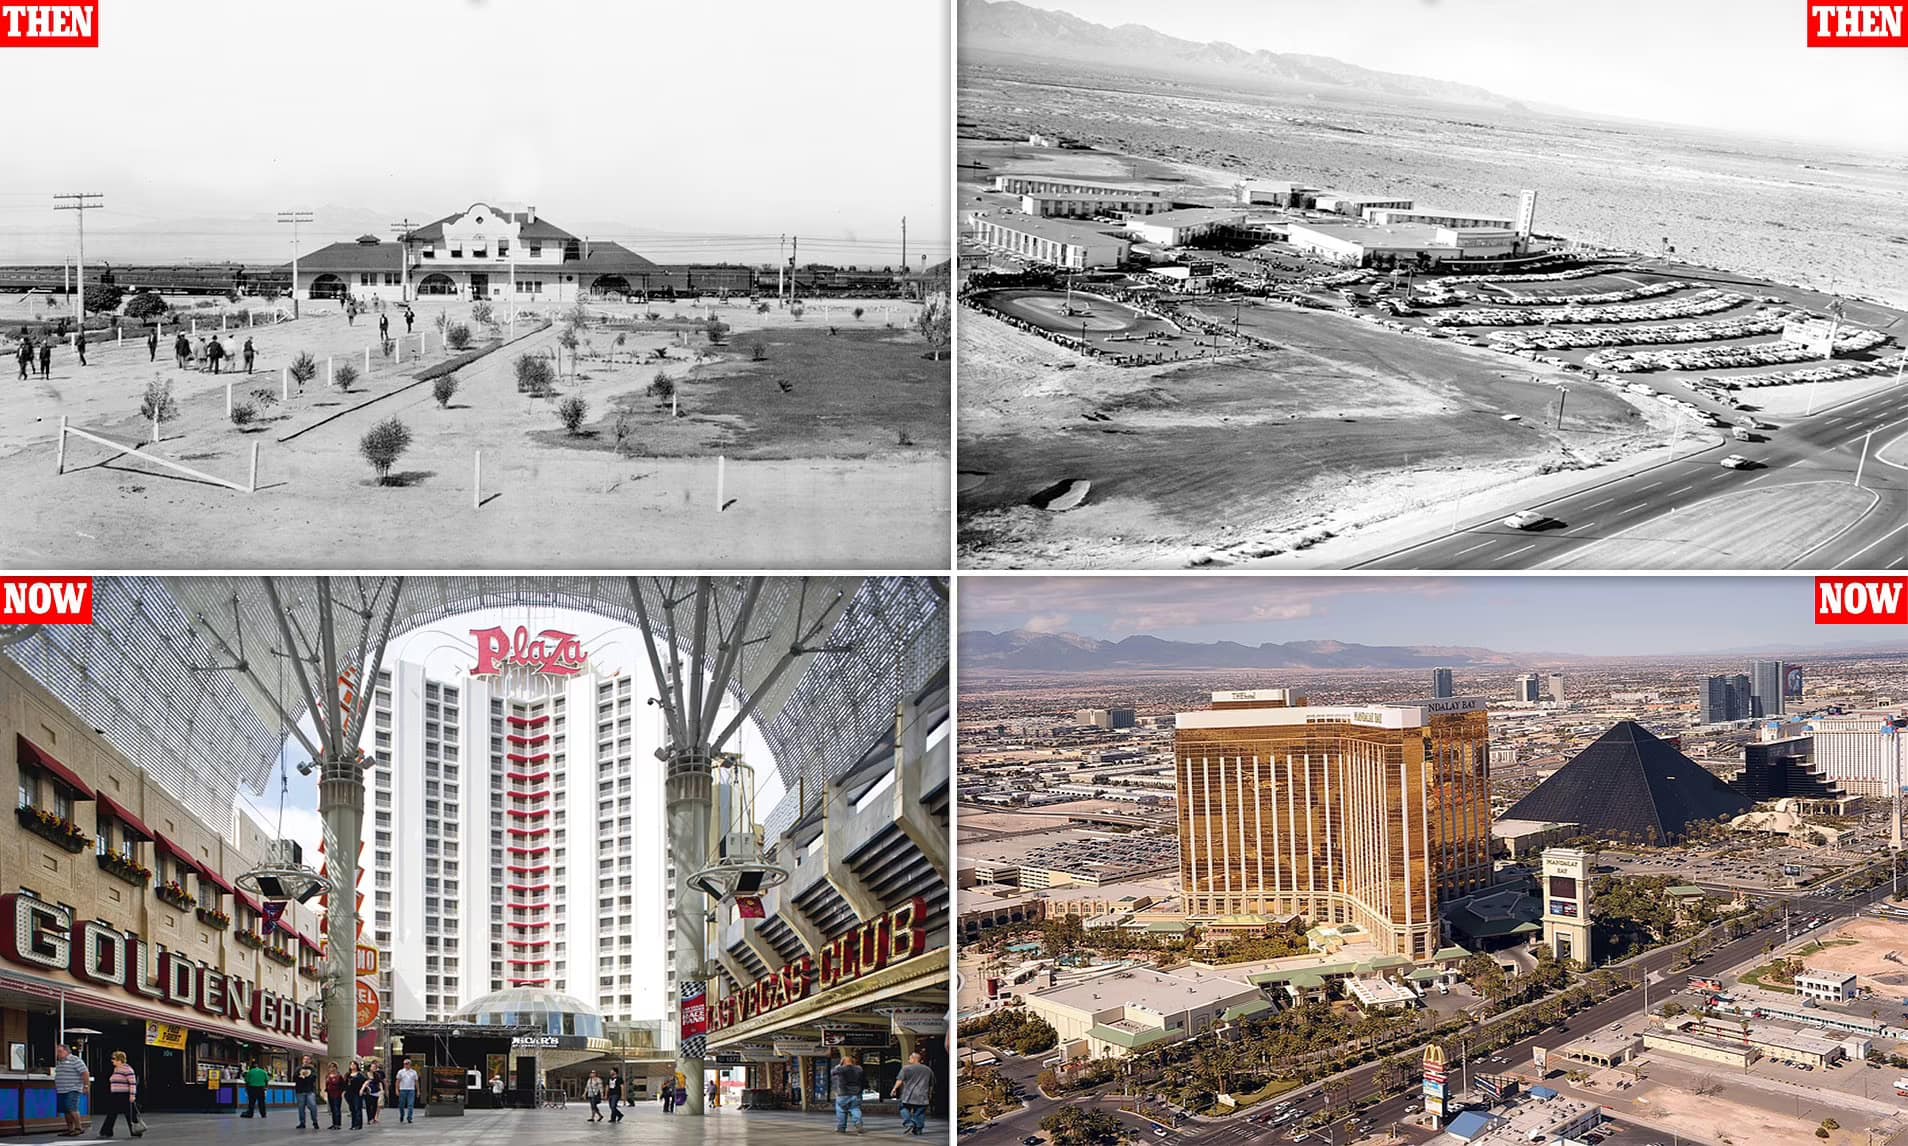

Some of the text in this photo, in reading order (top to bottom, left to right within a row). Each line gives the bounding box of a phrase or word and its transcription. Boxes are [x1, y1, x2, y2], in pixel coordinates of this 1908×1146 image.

[1428, 700, 1477, 713] NDALAY BAY
[12, 894, 252, 1020] GOLDEN
[736, 958, 804, 1020] VEGAS
[820, 899, 918, 989] CLUB
